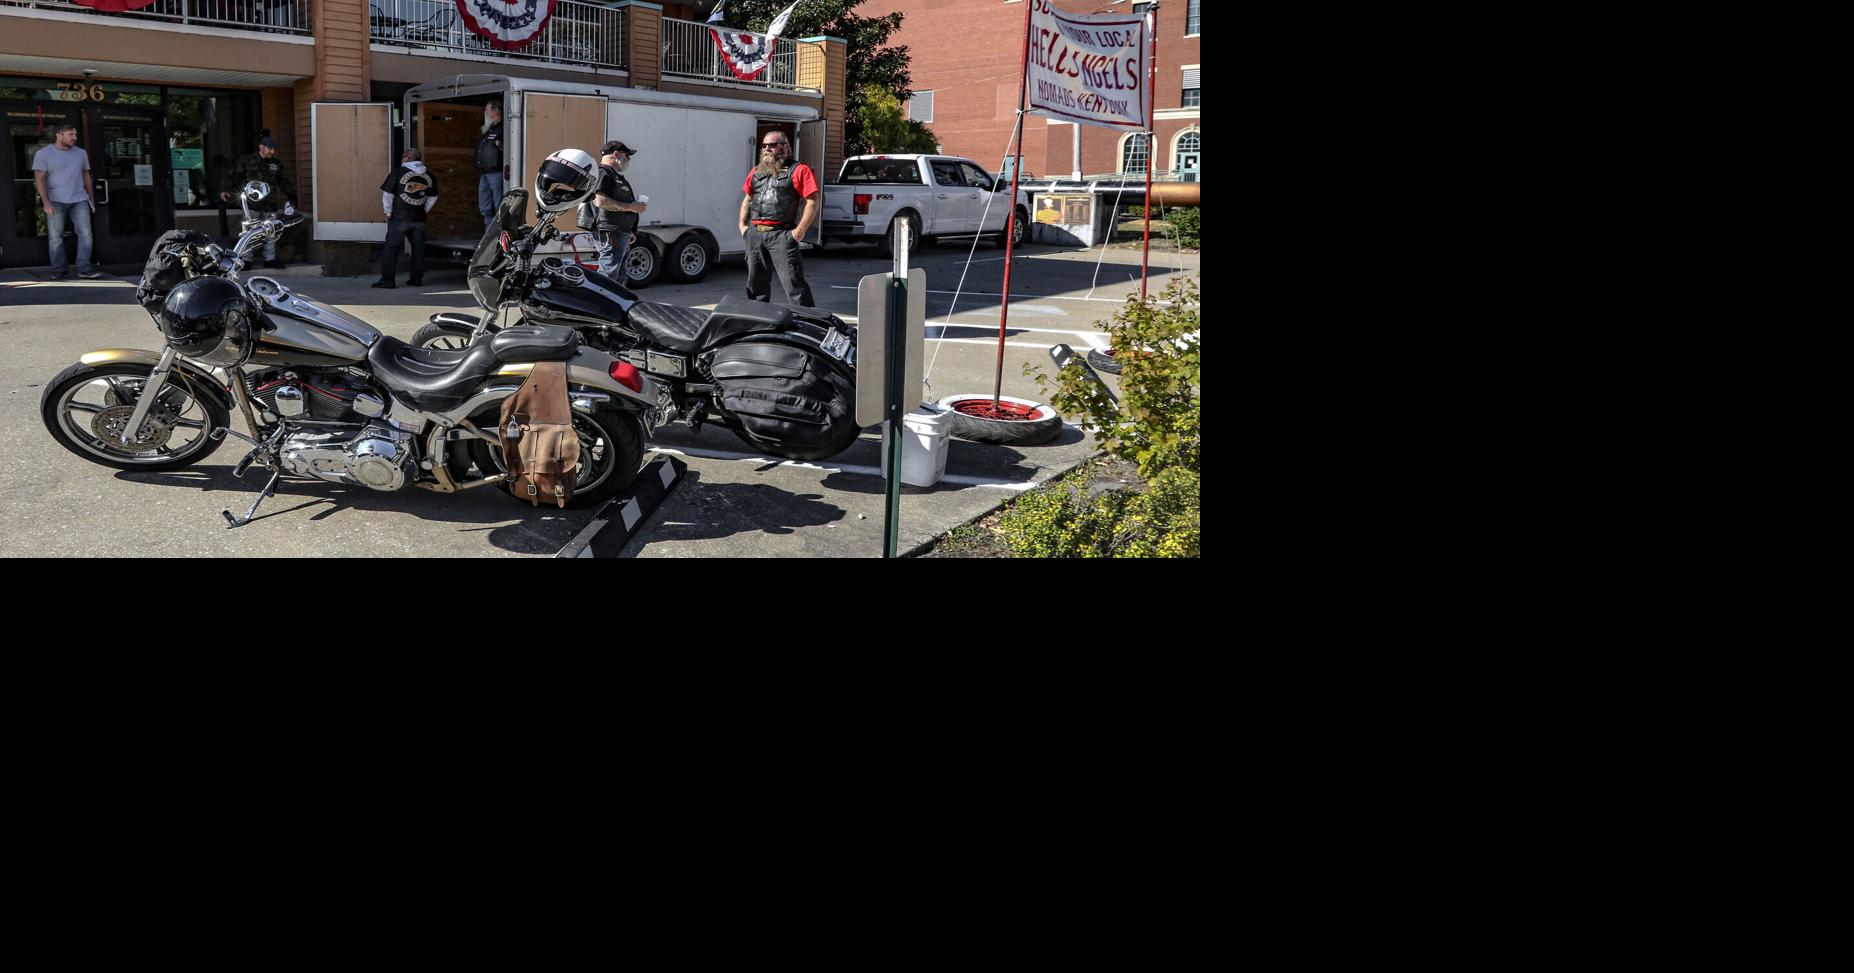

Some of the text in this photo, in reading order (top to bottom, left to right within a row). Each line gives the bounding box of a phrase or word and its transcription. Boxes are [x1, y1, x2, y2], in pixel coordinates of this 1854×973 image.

[1095, 30, 1136, 47] LOCAL
[1031, 24, 1138, 91] HELLS NGELS
[55, 82, 105, 101] 736
[1038, 80, 1076, 108] NOMADS
